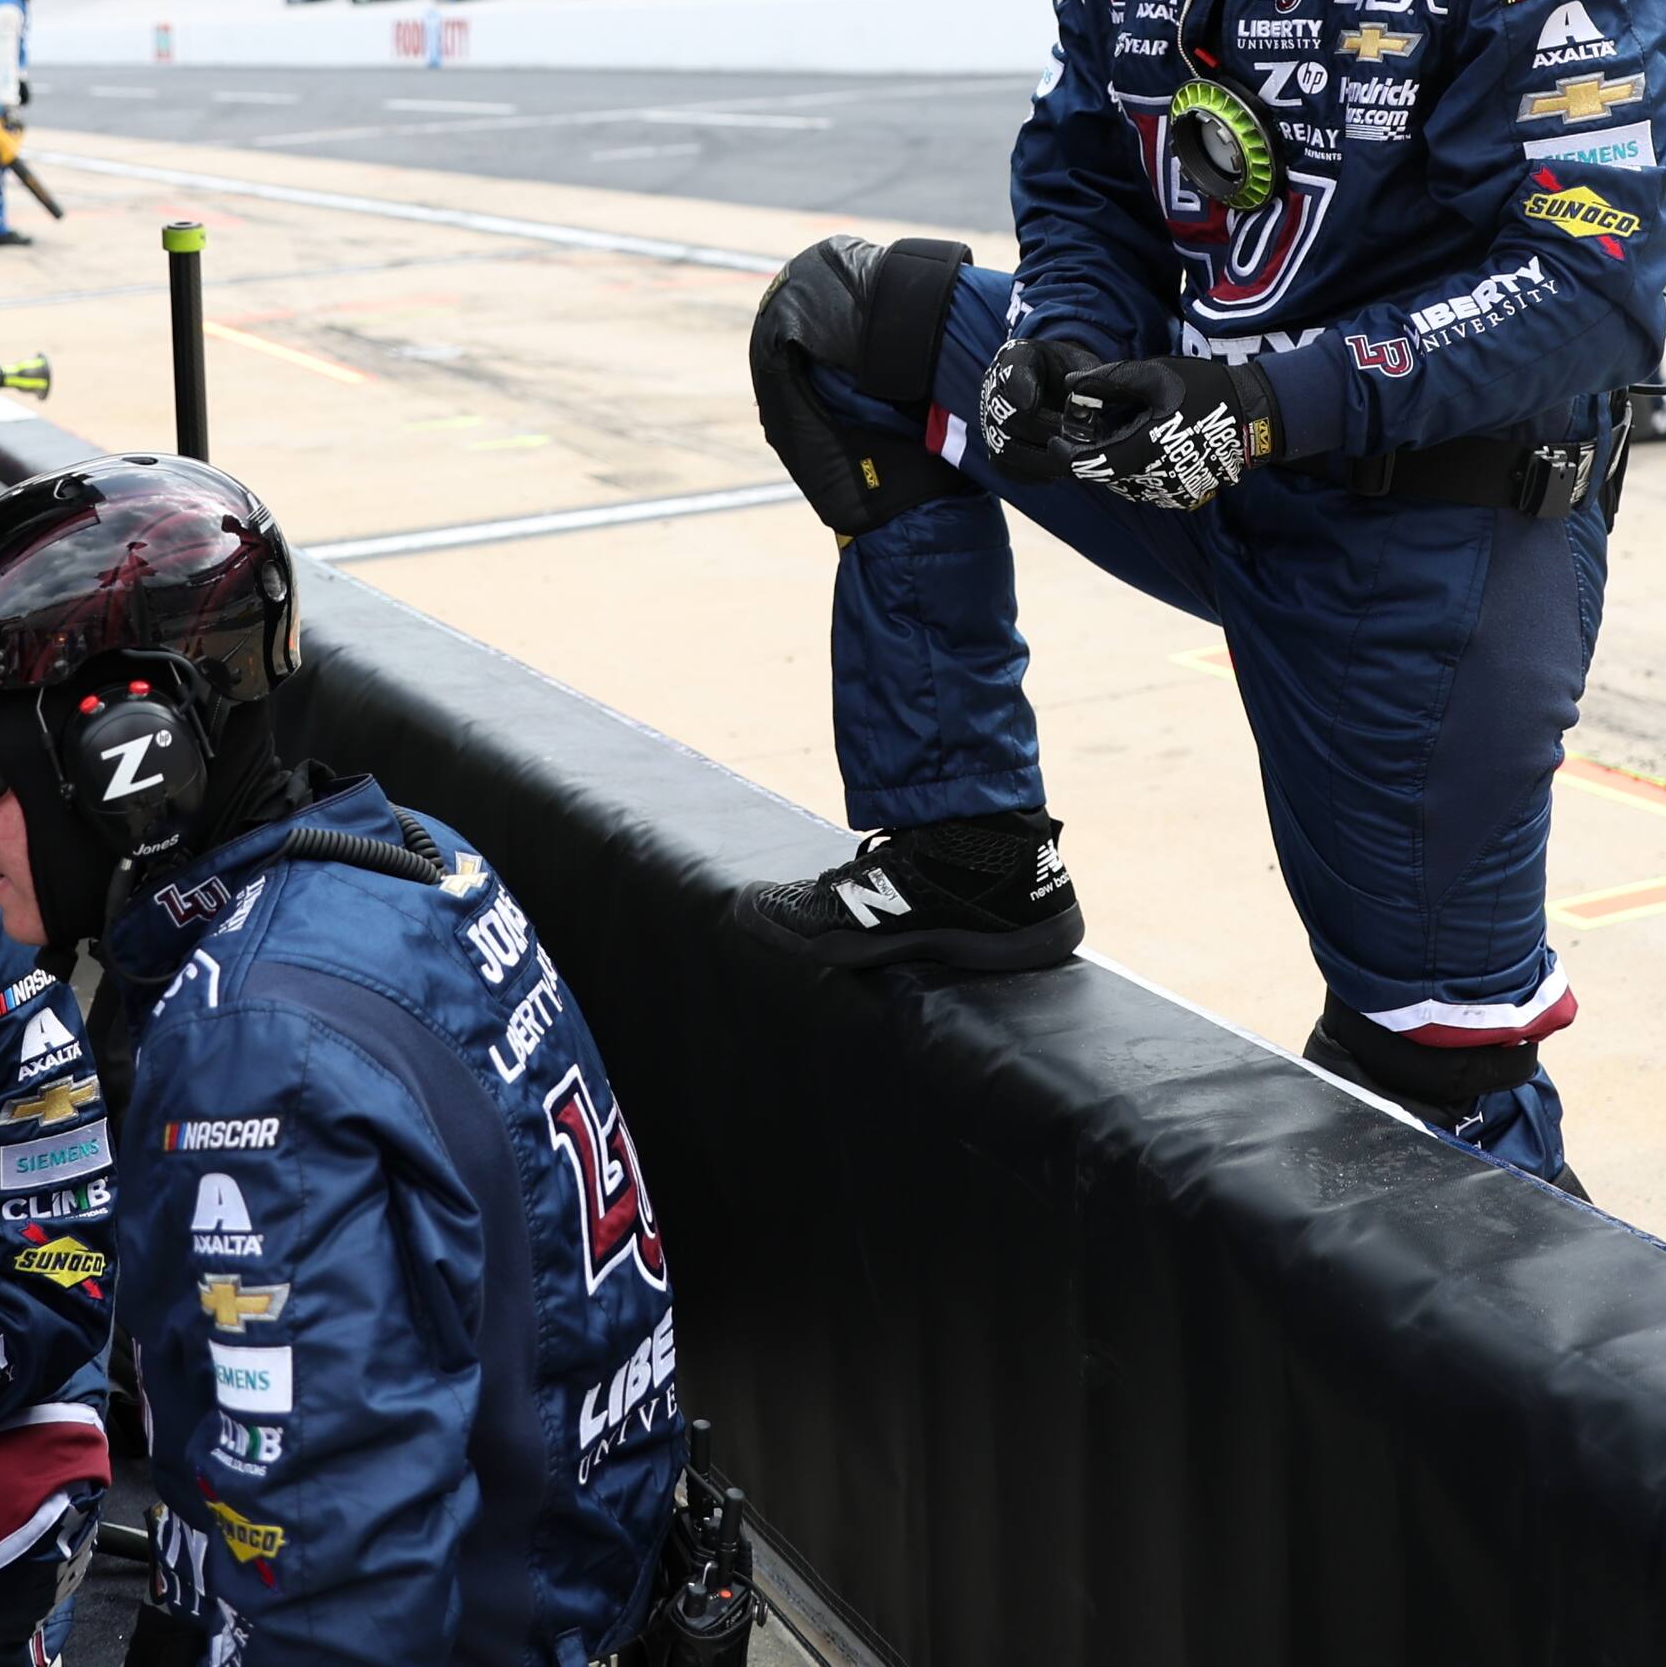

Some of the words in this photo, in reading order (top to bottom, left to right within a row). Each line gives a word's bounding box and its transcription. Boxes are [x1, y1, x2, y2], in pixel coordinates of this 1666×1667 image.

[1237, 19, 1323, 38] LIBERTY
[1237, 38, 1323, 50] UNIVERSITY
[1532, 40, 1615, 70] AXALTA
[1253, 60, 1303, 108] Z
[1528, 195, 1636, 235] SUNOCO
[1345, 334, 1415, 379] LU
[1420, 279, 1560, 358] NIVERSITY
[101, 733, 165, 802] Z
[133, 833, 180, 857] Jones
[18, 1042, 82, 1082] AXALTA
[183, 1117, 281, 1151] NASCAR
[16, 1138, 100, 1174] SIEMENS
[1, 1178, 111, 1221] CLIMB
[20, 1245, 105, 1274] SUNOCO
[580, 1305, 677, 1451] LIBE
[578, 1386, 678, 1485] UNIVE
